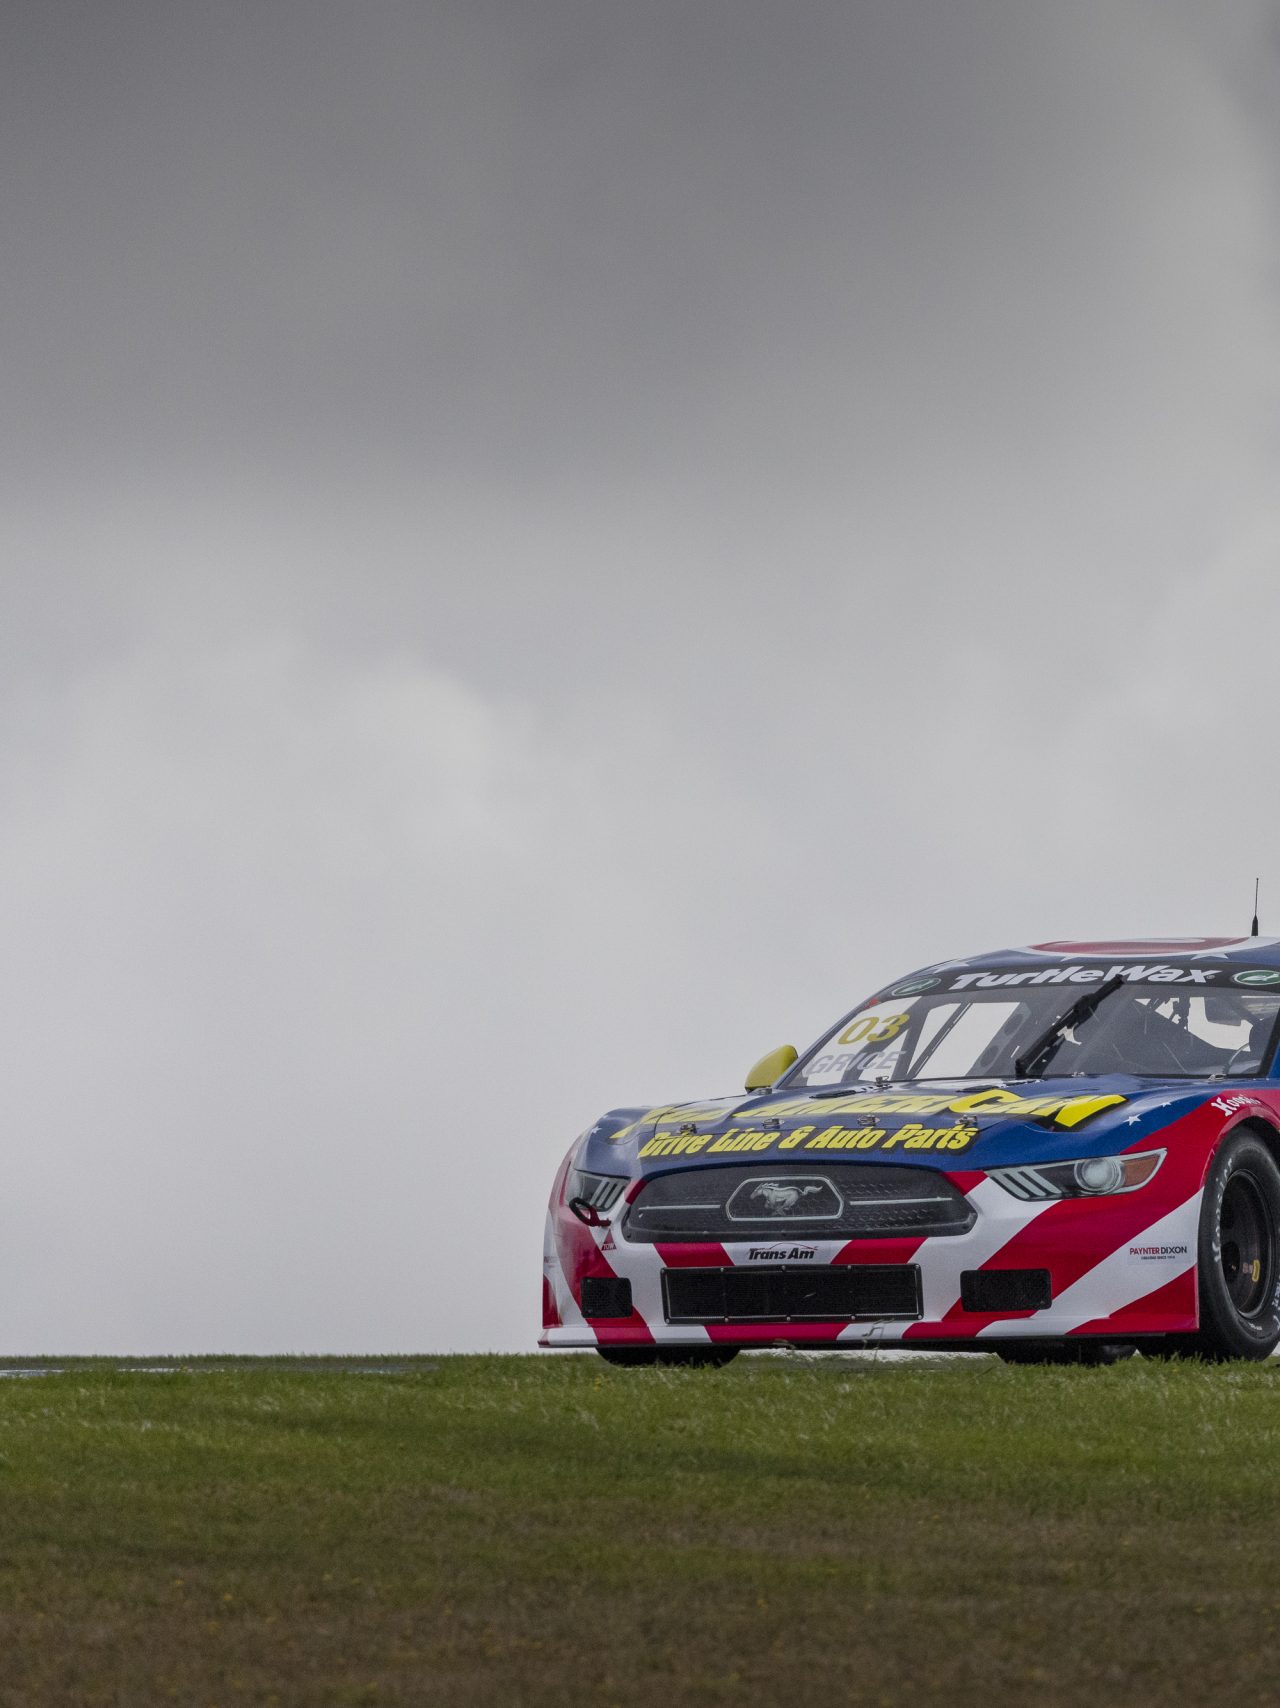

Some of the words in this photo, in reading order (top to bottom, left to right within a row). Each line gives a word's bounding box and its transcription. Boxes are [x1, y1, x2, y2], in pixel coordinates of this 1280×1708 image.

[837, 1013, 911, 1046] 03
[805, 1050, 906, 1076] GRICE
[637, 1131, 713, 1159] Drive
[707, 1127, 781, 1153] Line
[778, 1125, 816, 1150] &
[804, 1125, 881, 1149] Auto
[881, 1123, 980, 1150] Parts
[749, 1248, 787, 1260] Trans
[787, 1247, 815, 1260] Am
[1130, 1247, 1160, 1255] PAYNTER
[1160, 1246, 1188, 1254] DIXON
